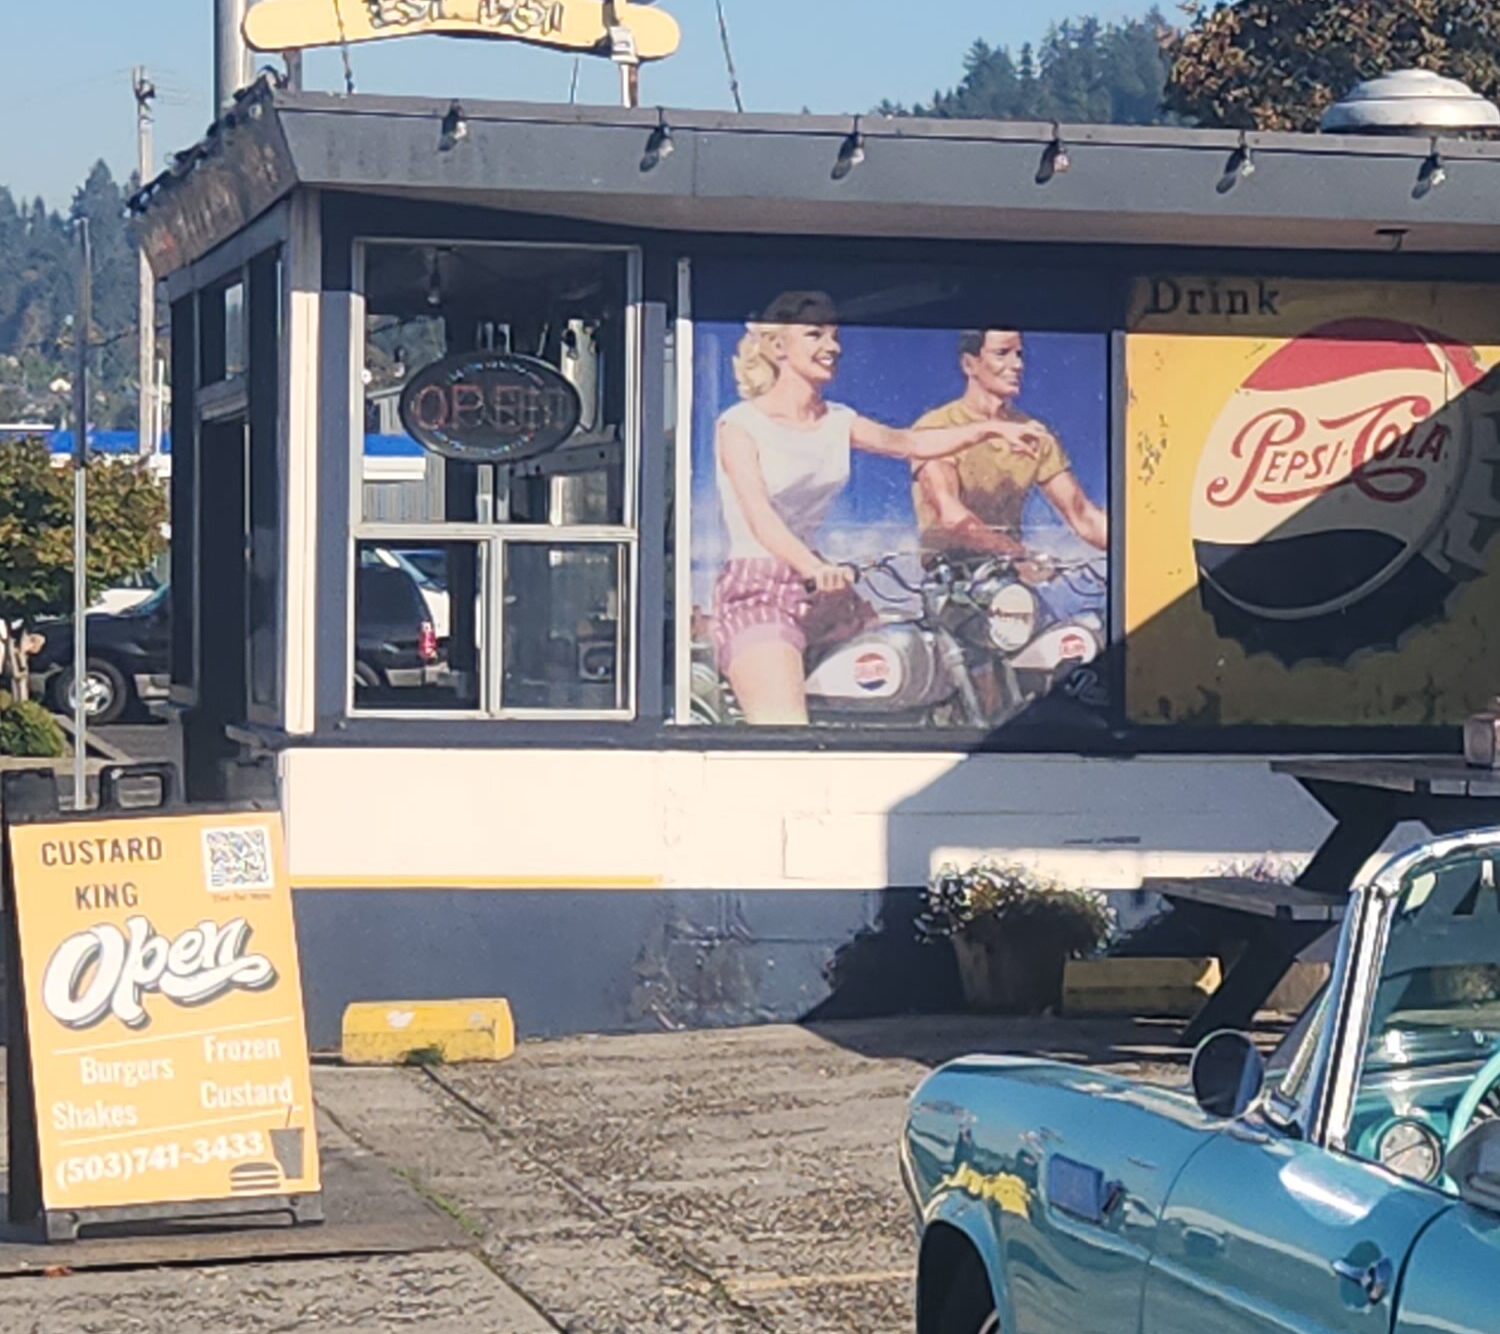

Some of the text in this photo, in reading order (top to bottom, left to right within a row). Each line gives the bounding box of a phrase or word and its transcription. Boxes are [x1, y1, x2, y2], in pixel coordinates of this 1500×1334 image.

[1145, 278, 1279, 316] Drink
[411, 384, 568, 431] OPEN
[41, 835, 164, 868] CUSTARD
[75, 882, 139, 911] KING
[42, 915, 280, 1032] Open
[204, 1034, 282, 1063] Frozen
[80, 1056, 175, 1087] Burgers
[200, 1077, 294, 1110] Custard
[52, 1101, 138, 1131] Shakes
